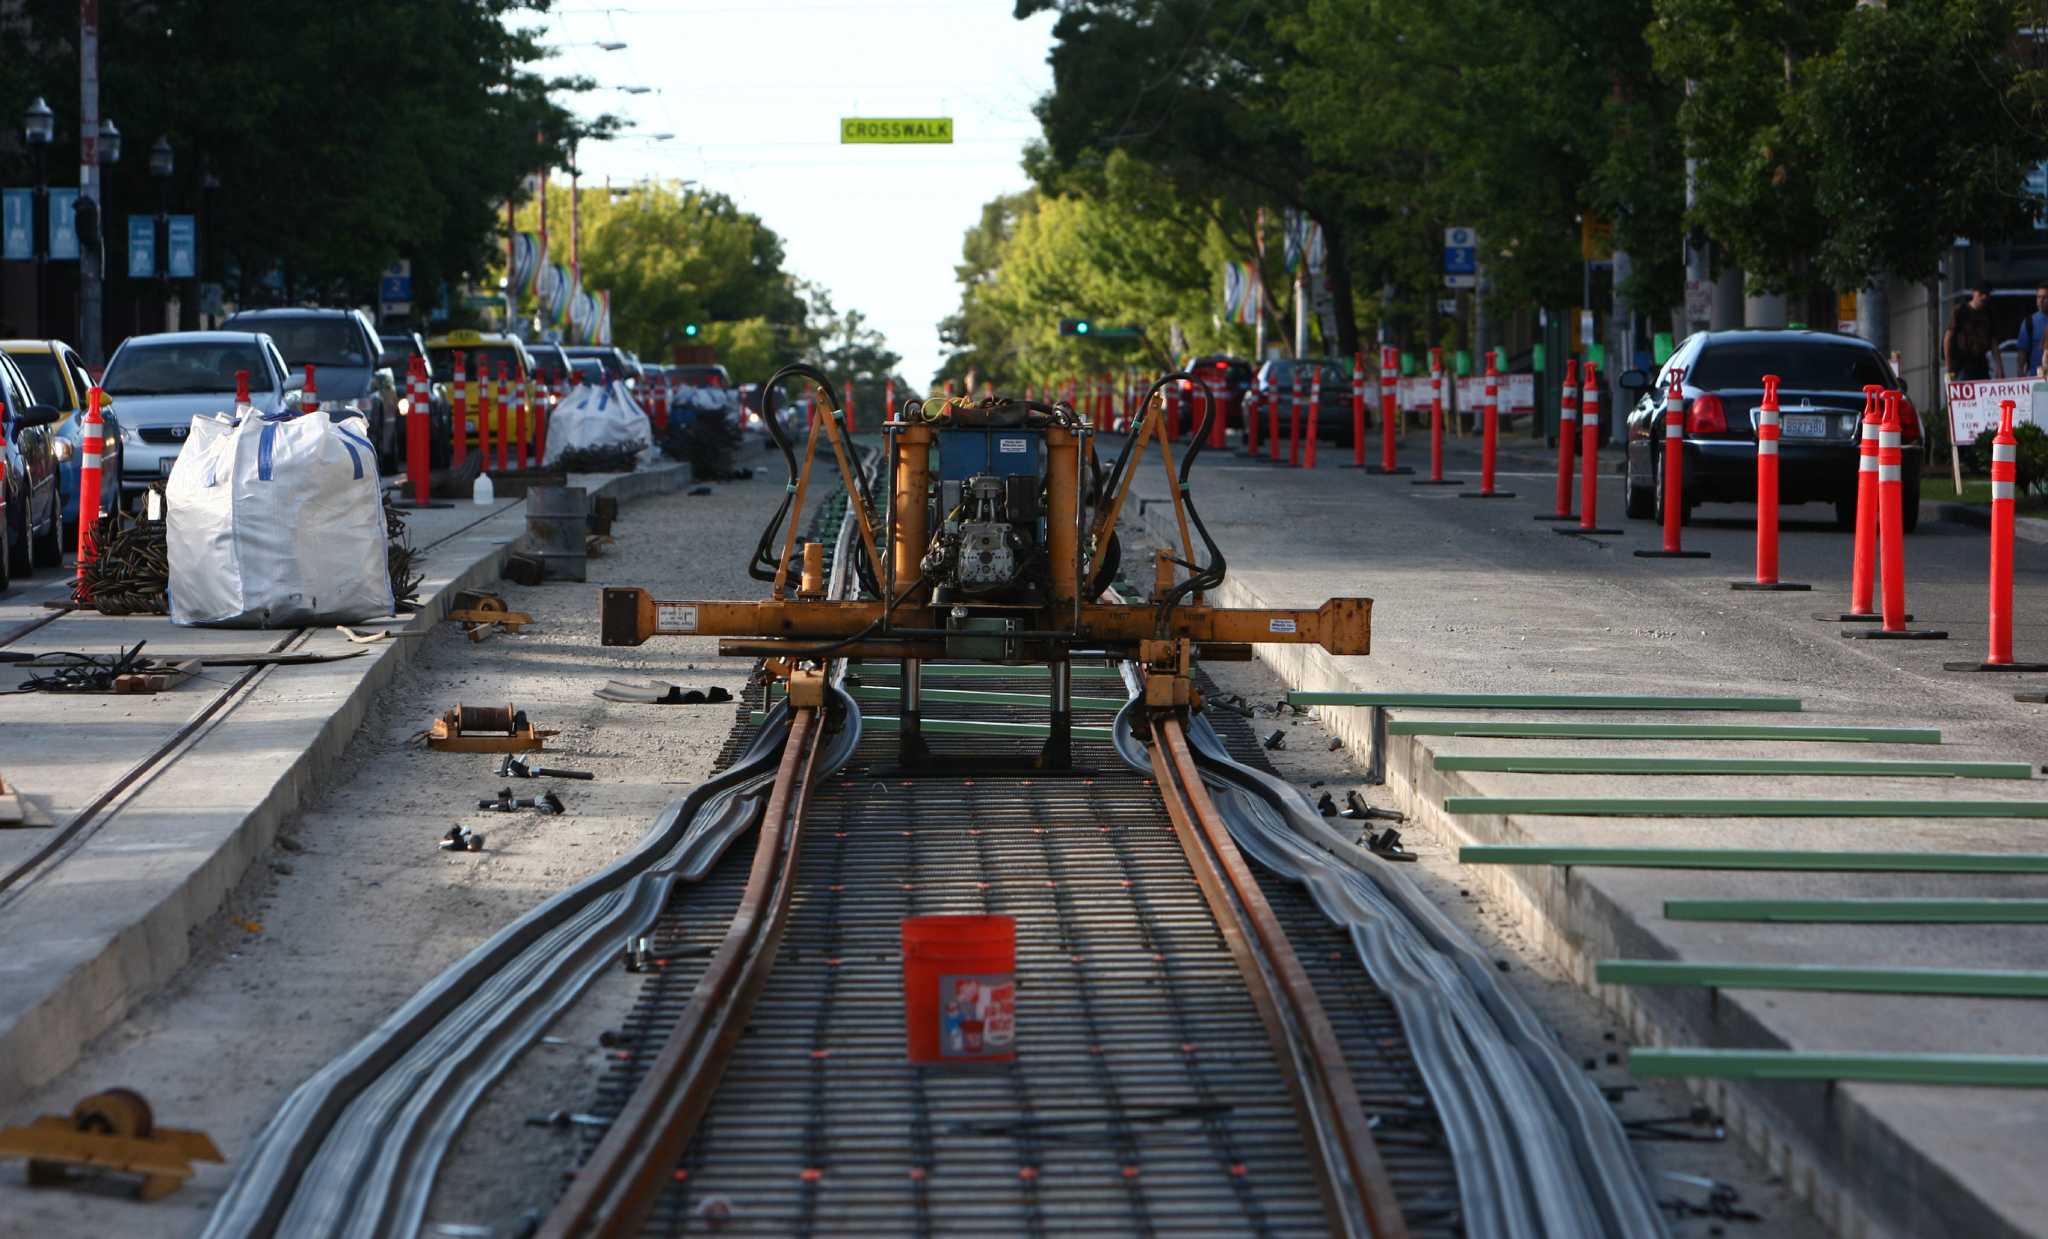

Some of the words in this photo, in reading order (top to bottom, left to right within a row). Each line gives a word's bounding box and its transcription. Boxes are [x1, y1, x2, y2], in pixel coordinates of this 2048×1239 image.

[845, 122, 949, 137] CROSSWALK
[1950, 383, 1974, 400] NO
[1979, 383, 2030, 397] PARKIN
